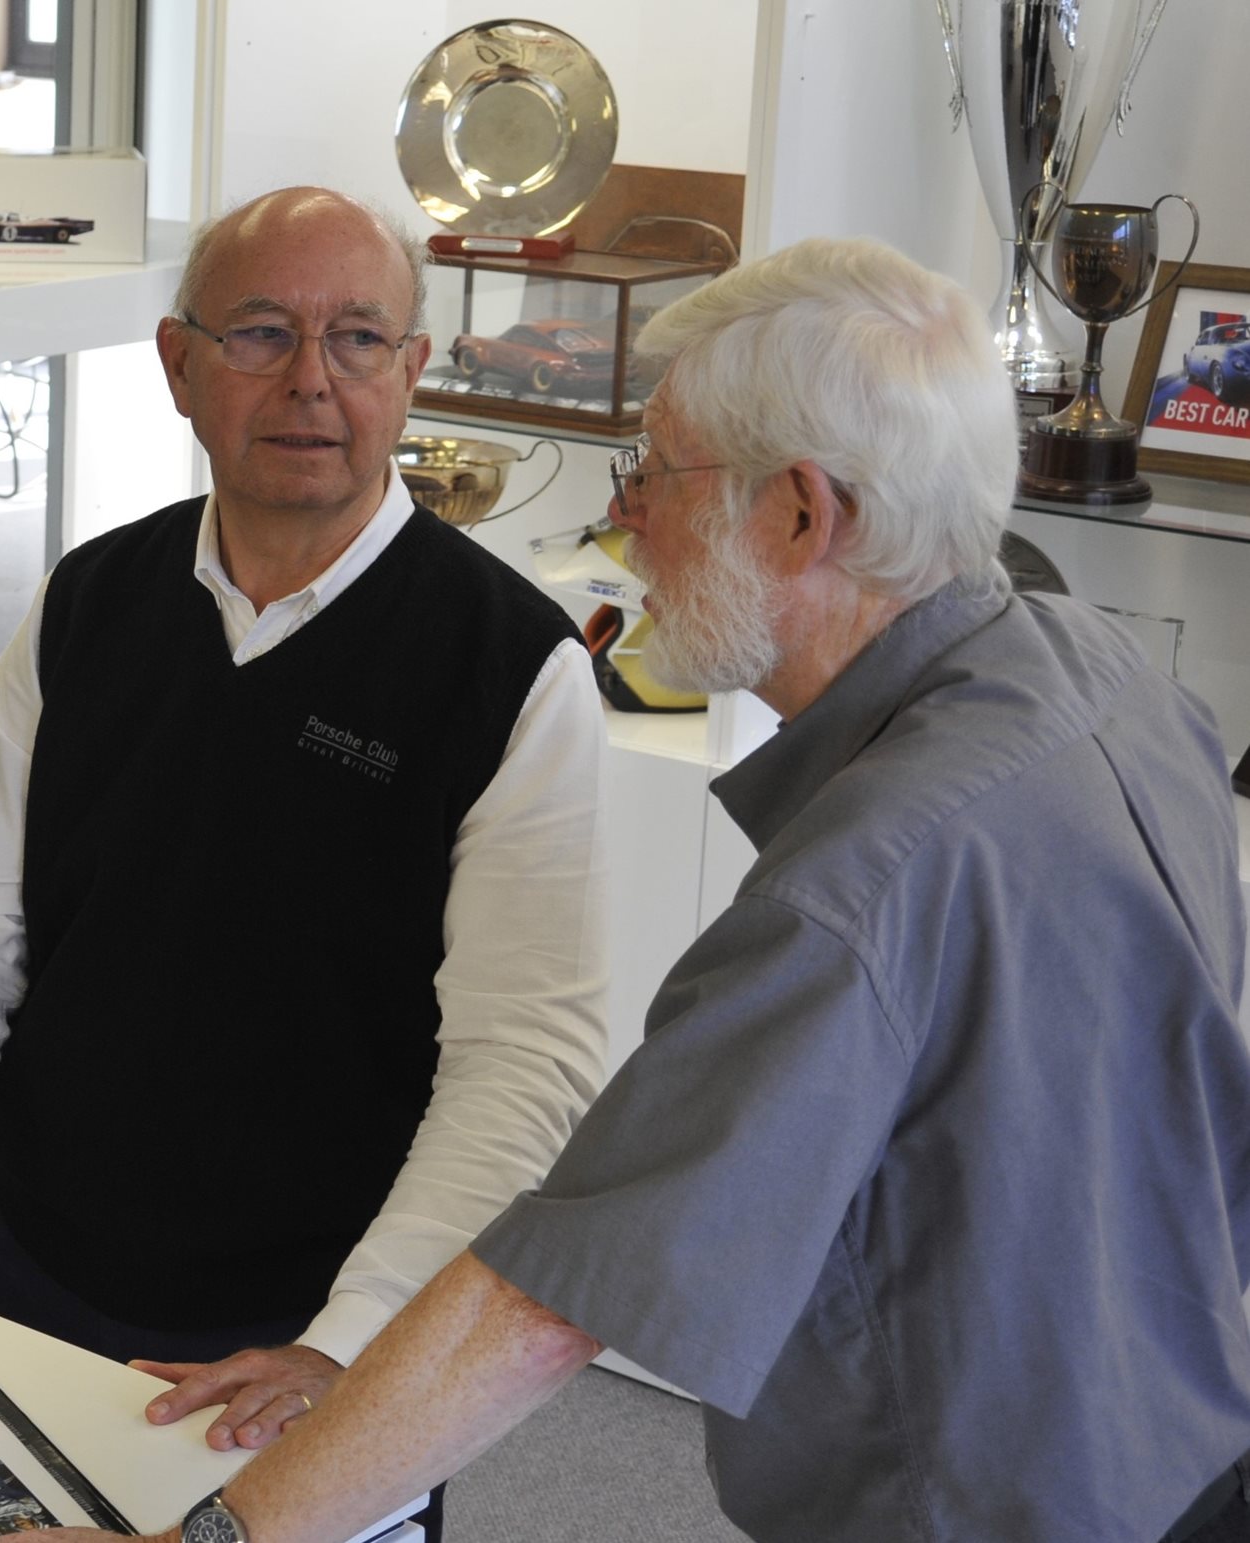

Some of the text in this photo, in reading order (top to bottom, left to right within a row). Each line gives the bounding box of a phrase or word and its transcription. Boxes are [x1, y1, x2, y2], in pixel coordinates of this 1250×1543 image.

[1164, 399, 1247, 429] BEST CAR
[305, 715, 399, 767] Porsche Club
